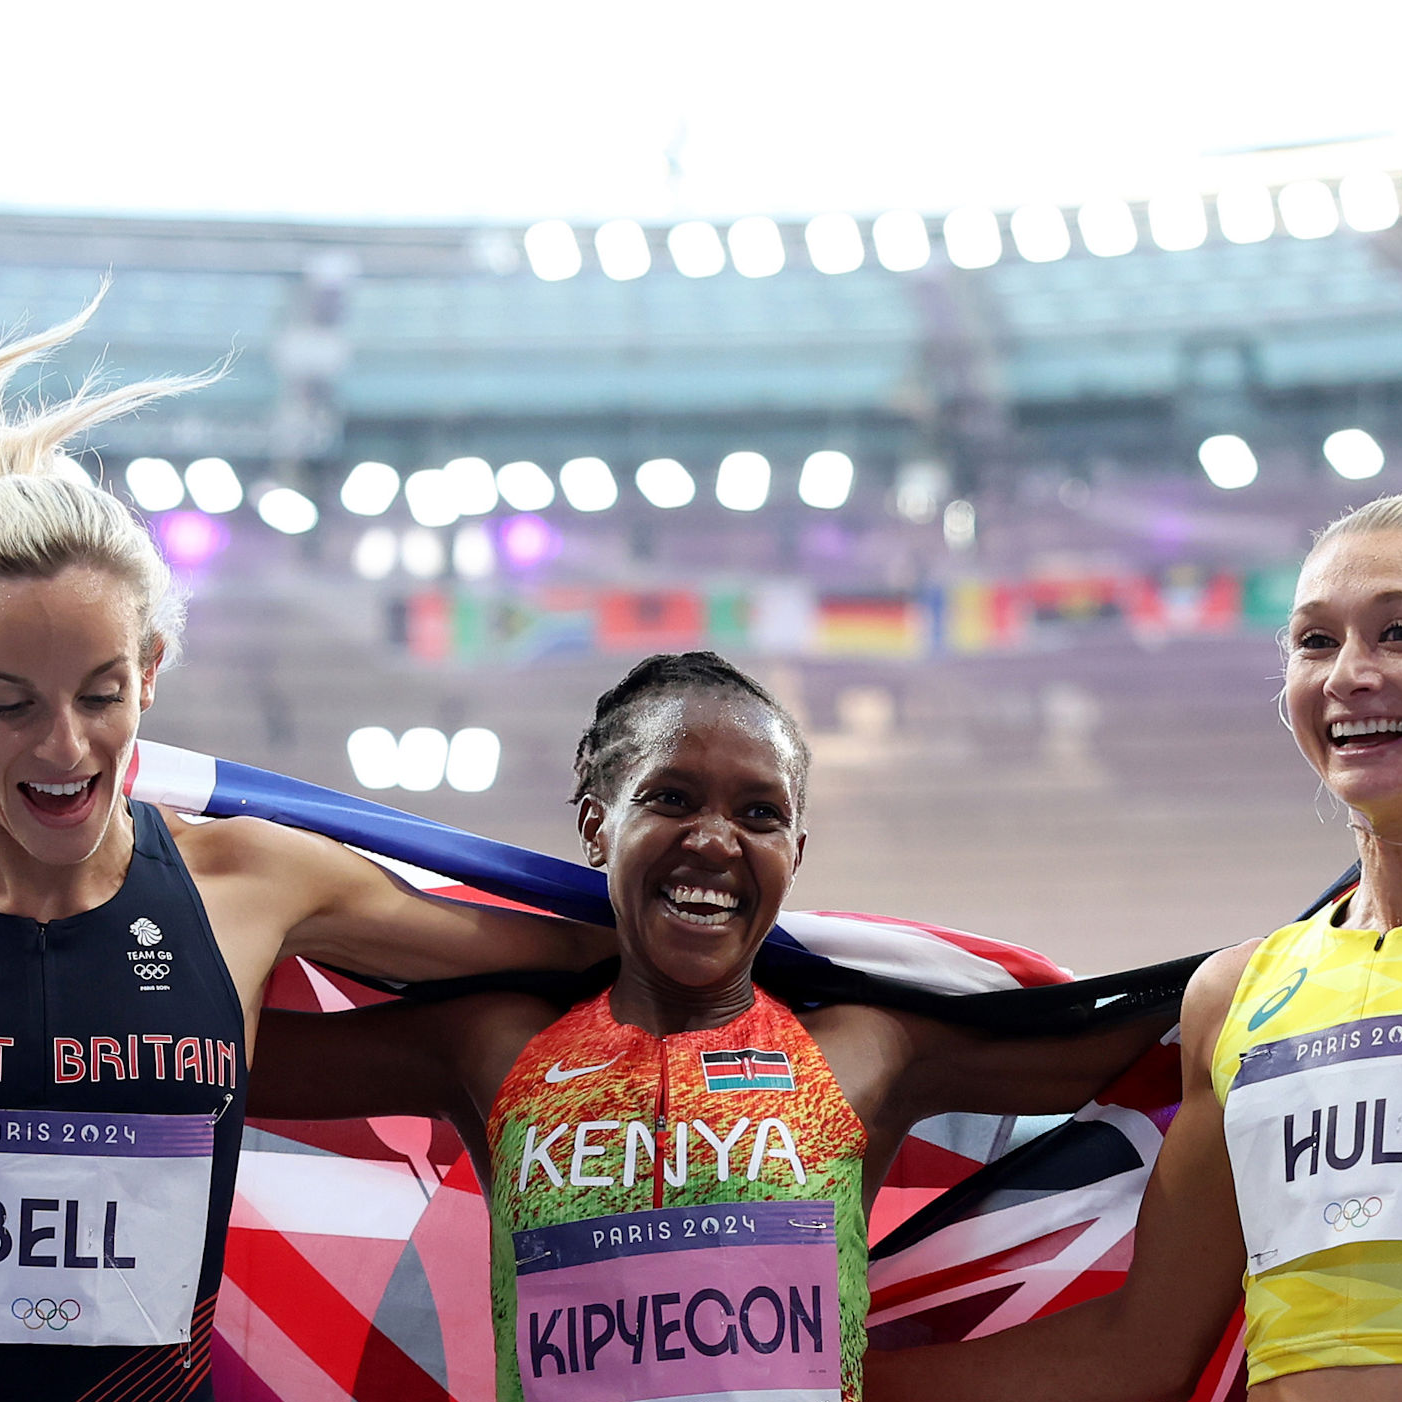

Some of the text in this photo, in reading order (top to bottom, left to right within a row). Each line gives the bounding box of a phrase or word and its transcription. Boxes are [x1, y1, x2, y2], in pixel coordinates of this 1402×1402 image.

[126, 950, 173, 961] TEAM GB
[53, 1034, 237, 1090] BRITAIN
[62, 1123, 137, 1145] 2024
[518, 1117, 808, 1193] KENYA
[683, 1214, 756, 1238] 2024
[529, 1285, 824, 1379] KIPYEGON
